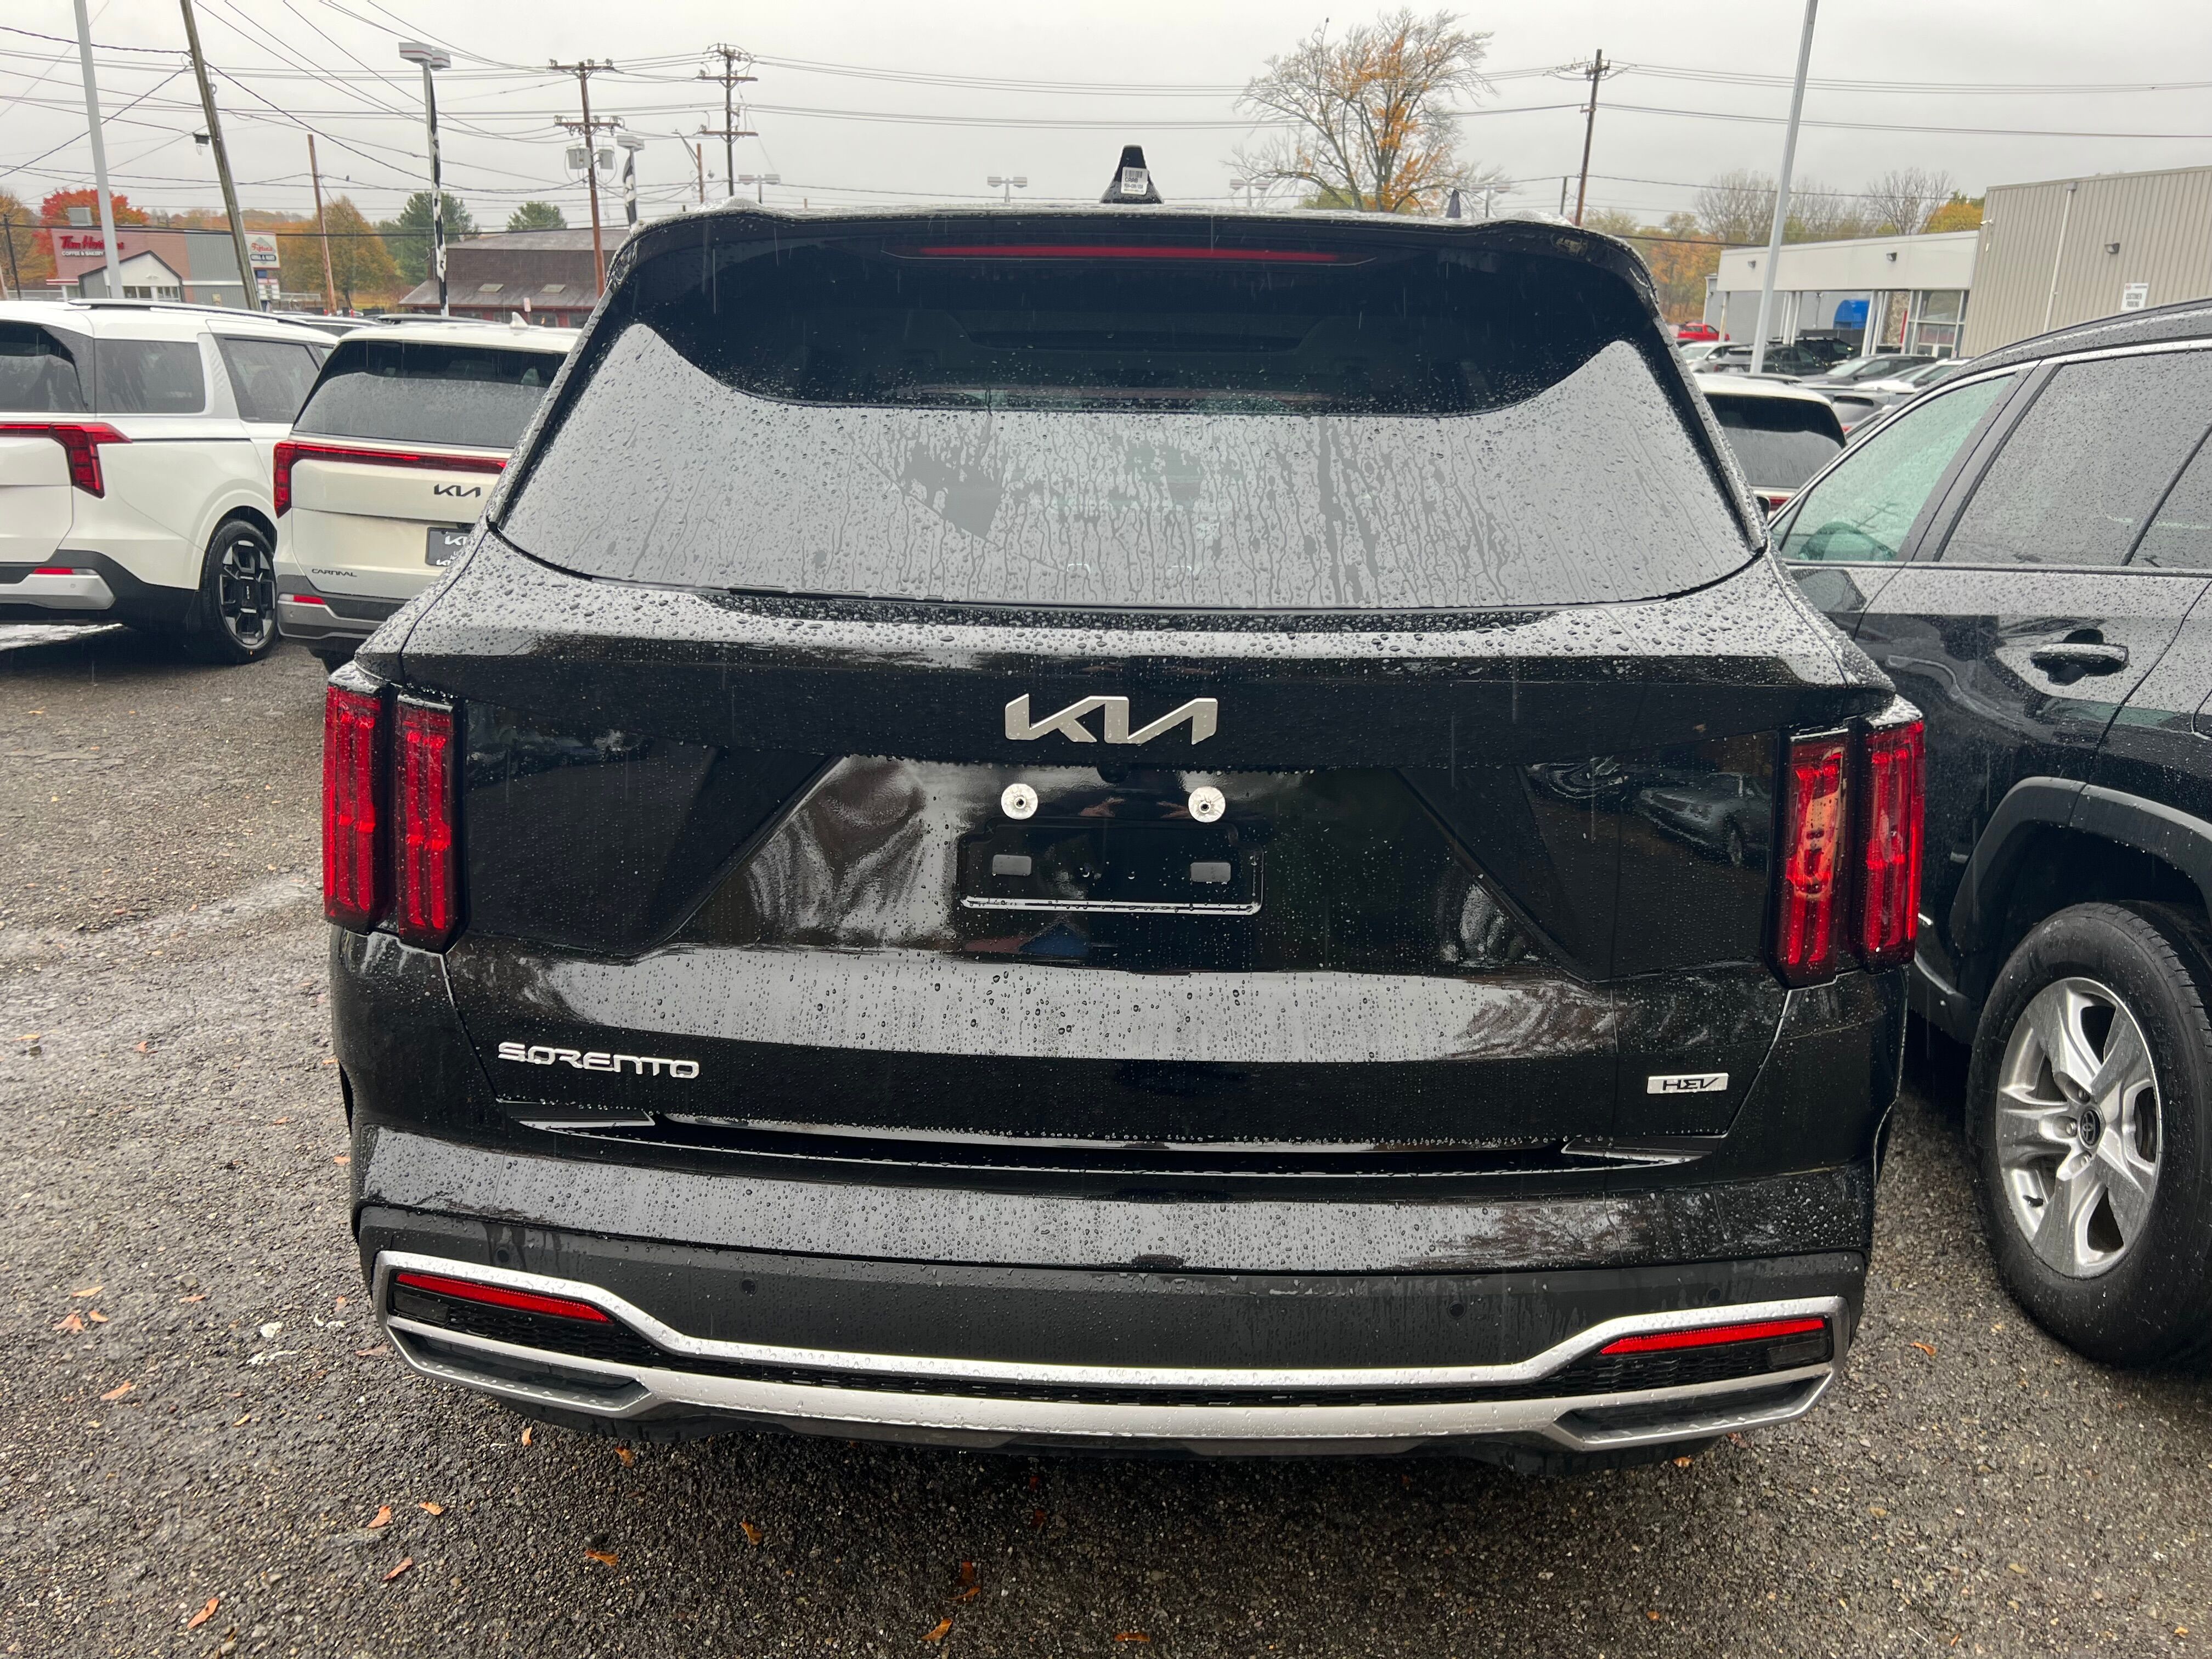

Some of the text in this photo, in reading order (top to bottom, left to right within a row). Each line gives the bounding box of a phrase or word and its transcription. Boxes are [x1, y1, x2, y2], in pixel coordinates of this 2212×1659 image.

[59, 235, 81, 249] Tim
[434, 484, 481, 498] KIA
[444, 535, 468, 546] KI
[312, 568, 358, 578] CARNIVAL
[1005, 693, 1218, 746] KIA
[498, 1041, 700, 1080] SORENTO
[1661, 1076, 1720, 1091] HEV
